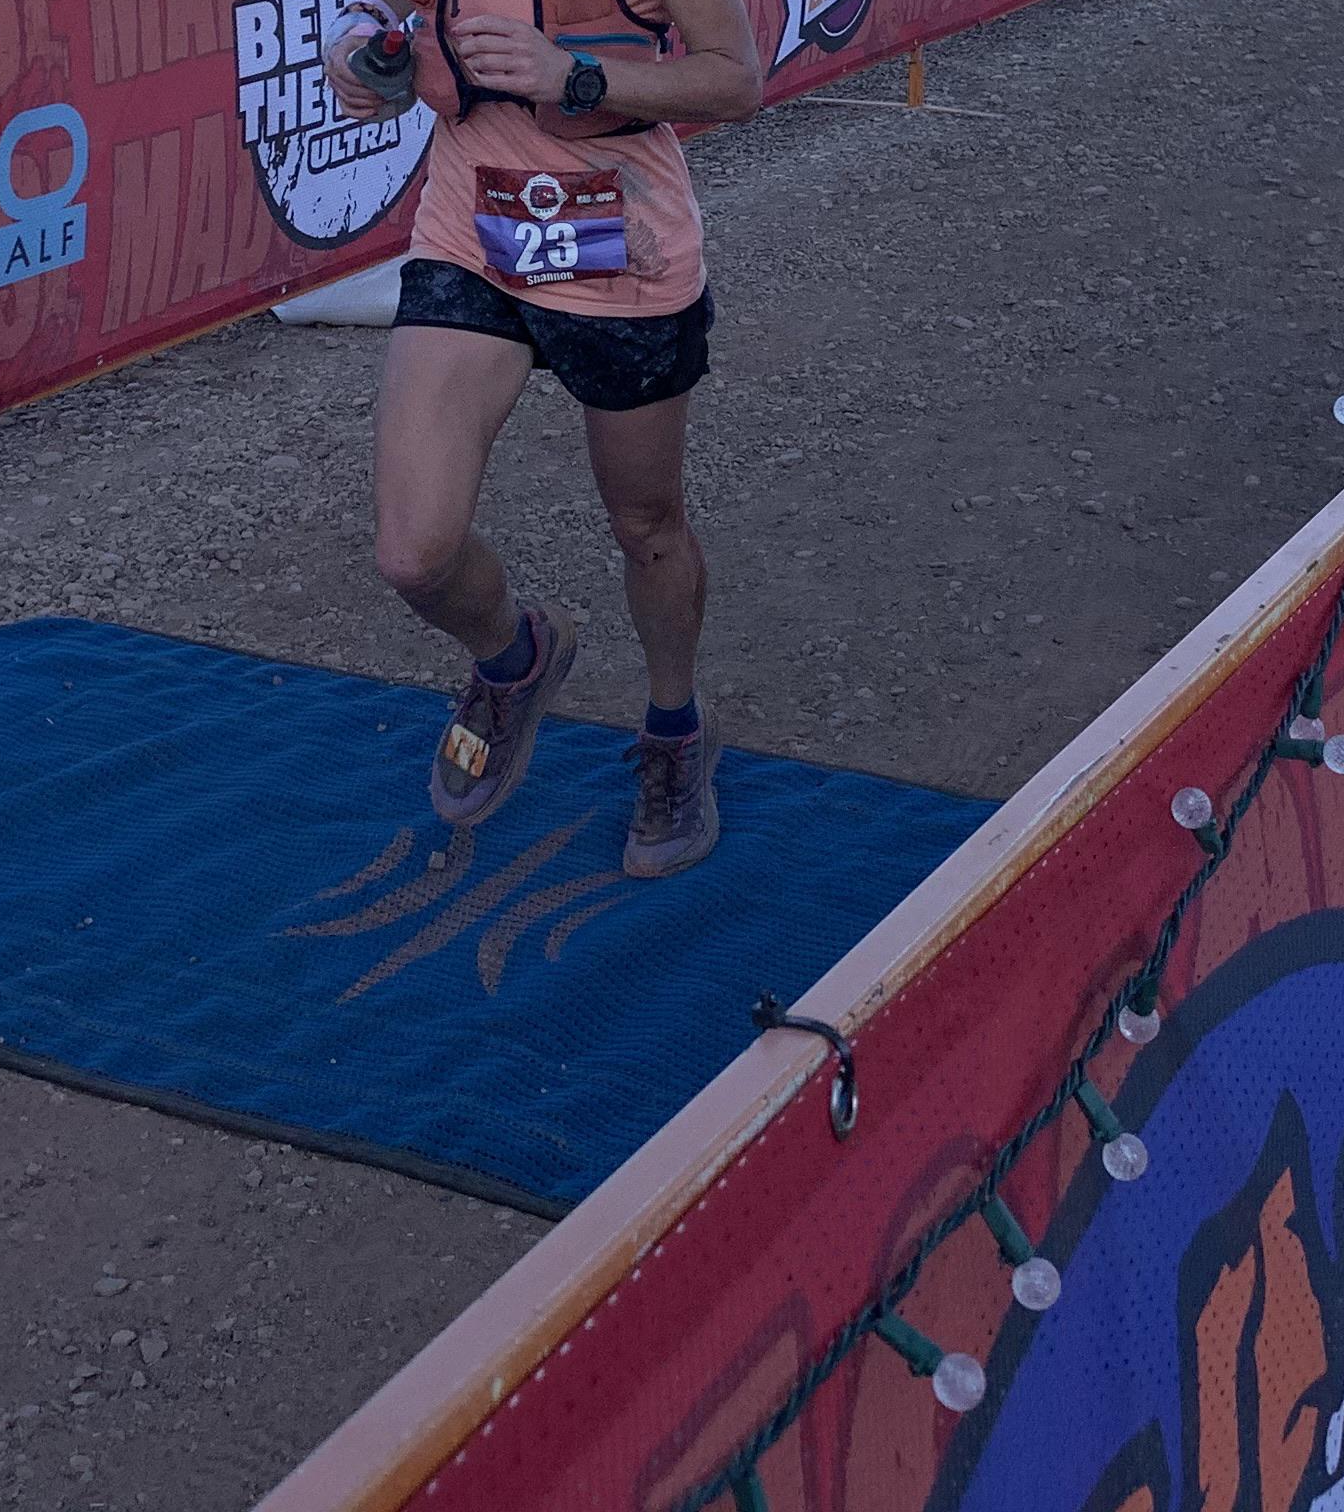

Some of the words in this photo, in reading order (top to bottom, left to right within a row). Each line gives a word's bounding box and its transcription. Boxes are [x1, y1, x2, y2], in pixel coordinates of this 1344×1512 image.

[239, 65, 325, 143] THE
[310, 122, 400, 170] ULTRA
[514, 221, 580, 273] 23
[526, 271, 574, 286] Shannon
